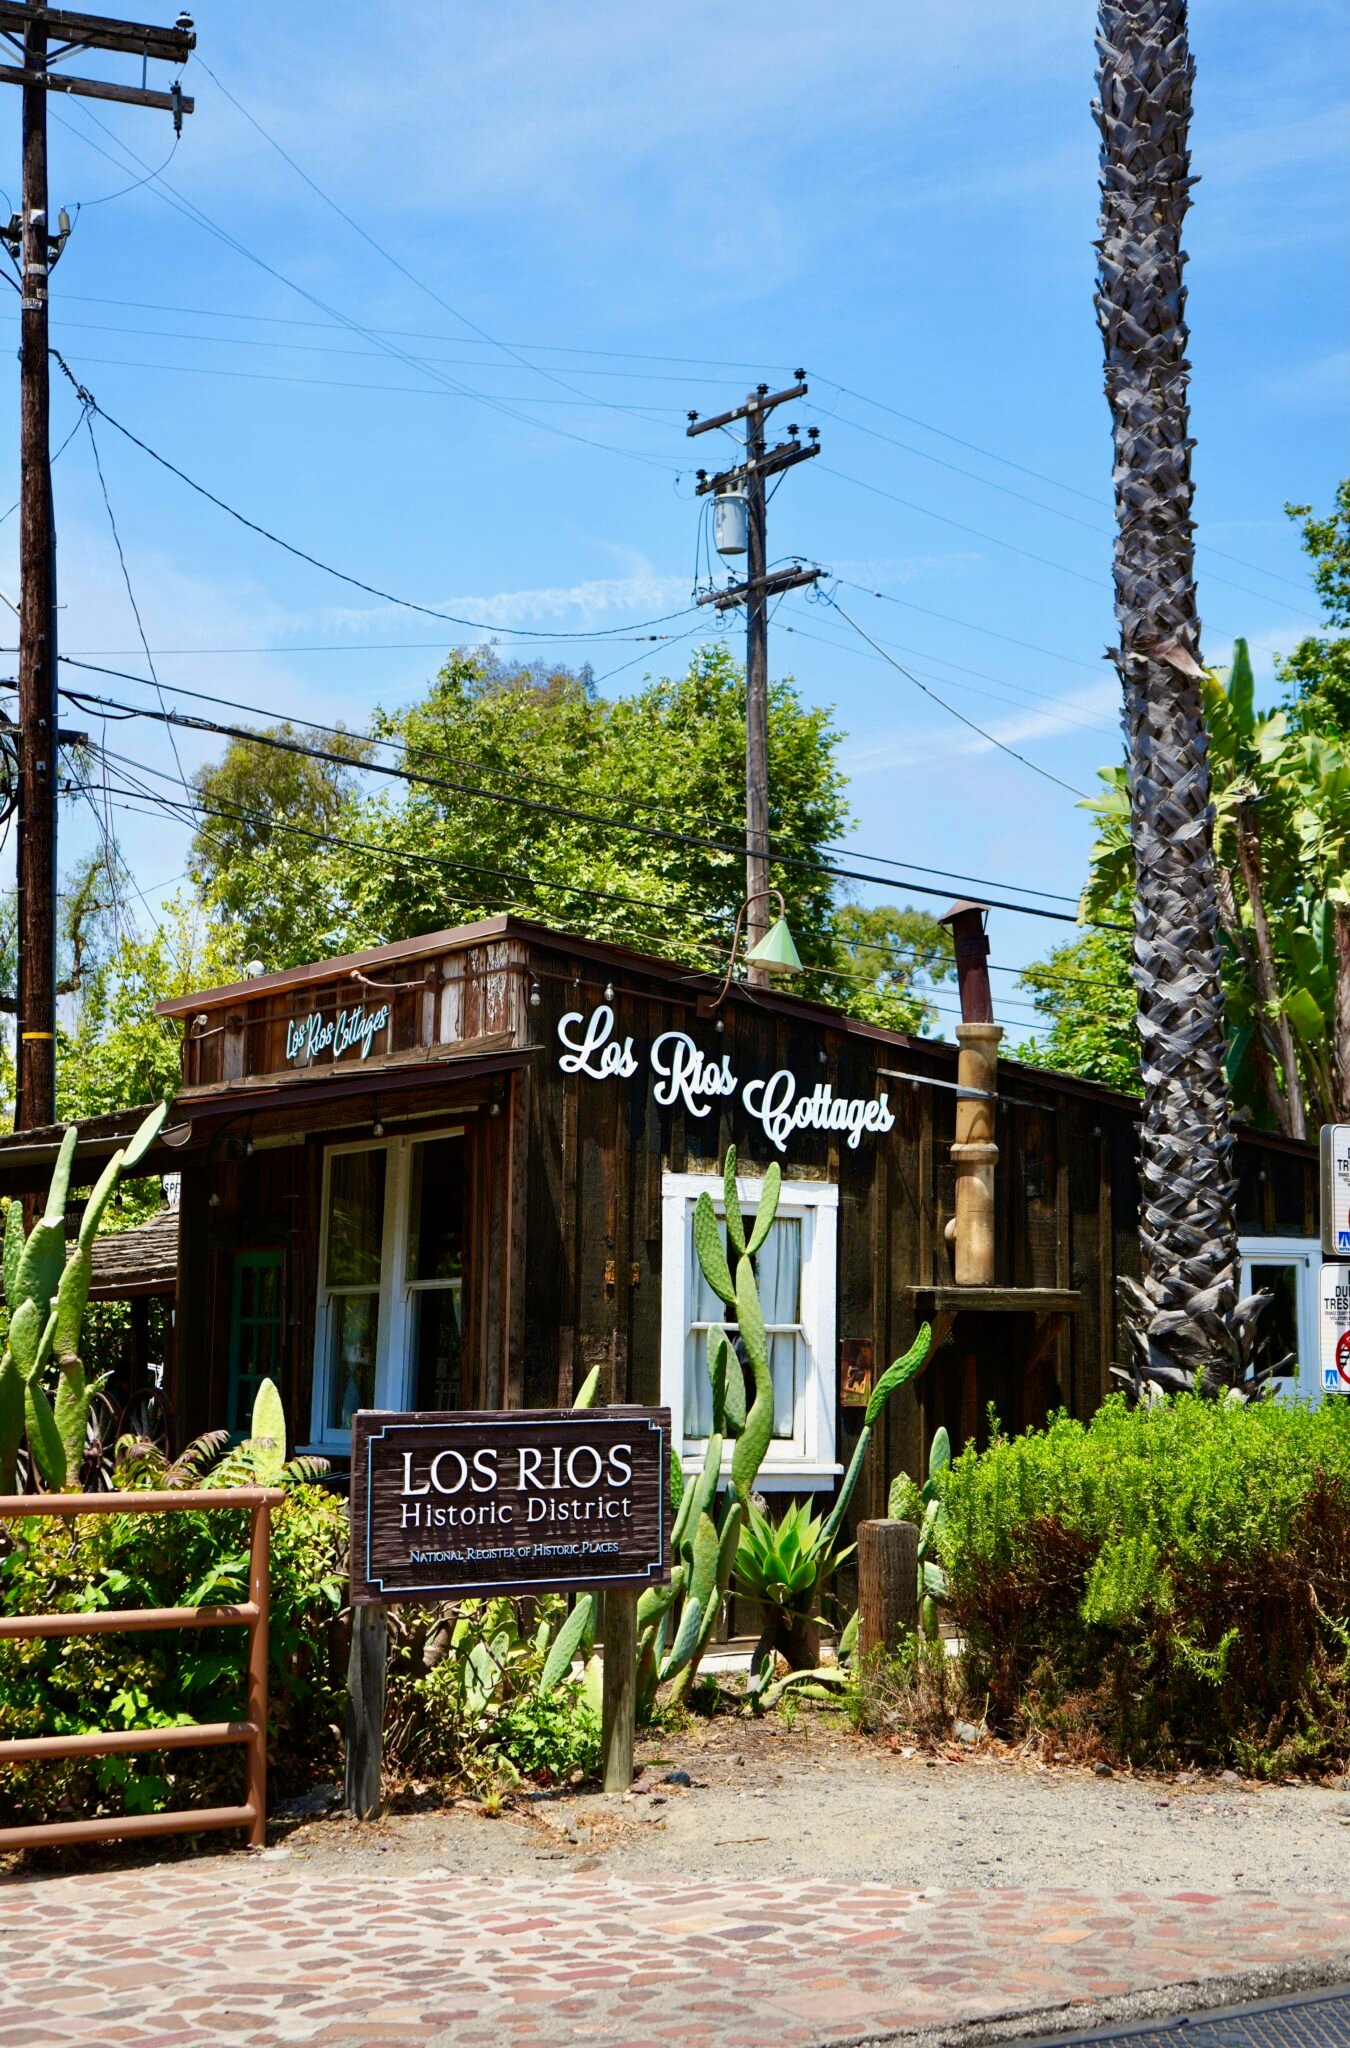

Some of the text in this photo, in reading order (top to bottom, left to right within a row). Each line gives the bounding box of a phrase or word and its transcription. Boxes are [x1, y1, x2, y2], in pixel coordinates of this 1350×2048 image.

[286, 1005, 390, 1060] Los Rios Cottages
[557, 1005, 895, 1152] Los Rios Cottages
[1324, 1298, 1350, 1310] TRES
[401, 1444, 632, 1496] LOS RIOS
[400, 1497, 632, 1528] Historic District
